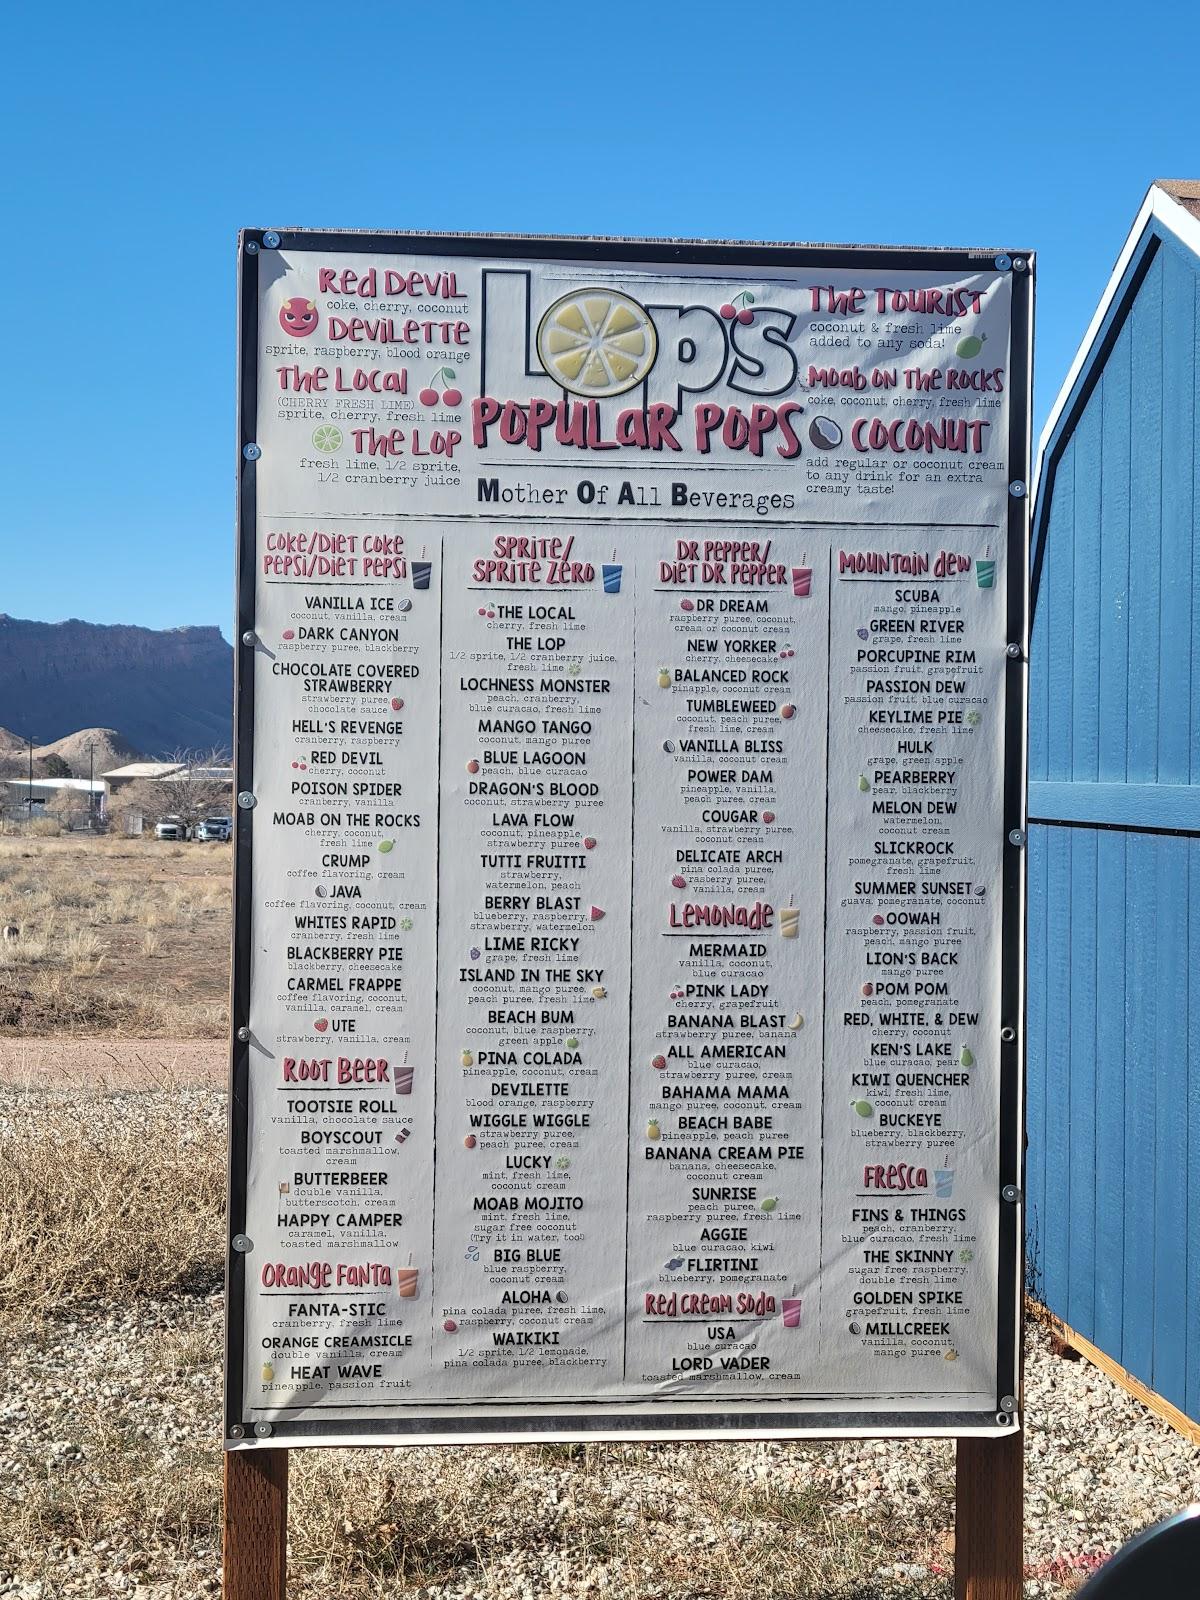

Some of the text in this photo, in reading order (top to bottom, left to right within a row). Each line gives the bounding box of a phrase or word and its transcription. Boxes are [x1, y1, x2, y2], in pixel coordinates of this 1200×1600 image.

[327, 299, 468, 314] coke, cherry, coconut
[810, 322, 961, 335] coconut & fresh lime
[810, 336, 944, 351] added to any soda!
[266, 344, 470, 363] sprite, raspberry, blood orange
[808, 396, 1000, 409] coke, coconut, cherry, fresh lime
[278, 409, 461, 423] sprite, cherry, fresh lime
[300, 458, 460, 473] fresh lime, 1/2 sprite,
[807, 457, 828, 467] add
[835, 458, 887, 473] regular
[913, 461, 962, 469] coconut
[318, 473, 460, 487] 1/2 cranberry juice
[806, 470, 983, 483] to any drink for an extra
[478, 478, 794, 515] Mother Of All Beverages
[807, 484, 894, 496] creamy taste!
[895, 590, 940, 602] SCUBA
[305, 596, 393, 610] VANILLA ICE
[870, 620, 964, 633] GREEN RIVER
[299, 627, 398, 641] DARK CANYON
[688, 640, 776, 652] NEW YORKER
[461, 678, 610, 693] LOCHNESS MONSTER
[687, 700, 776, 712] TUMBLEWEED
[293, 720, 402, 734] HELL'S REVENGE
[479, 720, 591, 734] MANGO TANGO
[484, 751, 585, 765] BLUE LAGOON
[688, 770, 772, 783] POWER DAM
[875, 771, 955, 784] PEARBERRY
[273, 812, 420, 827] MOAB ON THE ROCKS
[493, 813, 574, 827] LAVA FLOW
[703, 810, 757, 823] COUGAR
[875, 842, 953, 854] SLICKROCK
[323, 855, 370, 867] CRUMP
[481, 855, 586, 868] TUTTI FRUITTI
[855, 882, 972, 894] SUMMER SUNSET
[485, 937, 579, 951] LIME RICKY
[690, 944, 766, 956] MERMAID
[867, 953, 957, 965] LION'S BACK
[288, 978, 401, 991] CARMEL FRAPPE
[686, 985, 768, 997] PINK LADY
[489, 1011, 574, 1023] BEACH BUM
[679, 1117, 772, 1129] BEACH BABE
[880, 1114, 941, 1126] BUCKEYE
[302, 1131, 382, 1144] BOYSCOUT
[507, 1156, 551, 1168] LUCKY
[295, 1172, 387, 1185] BUTTERBEER
[693, 1188, 756, 1200] SUNRISE
[700, 1228, 747, 1241] AGGIE
[494, 1249, 560, 1262] BIG BLUE
[854, 1292, 962, 1304] GOLDEN SPIKE
[866, 1323, 949, 1335] MILLCREEK
[262, 1336, 412, 1348] ORANGE CREAMSICLE
[493, 1332, 559, 1345] WAIKIKI
[673, 1357, 770, 1370] LORD VADER
